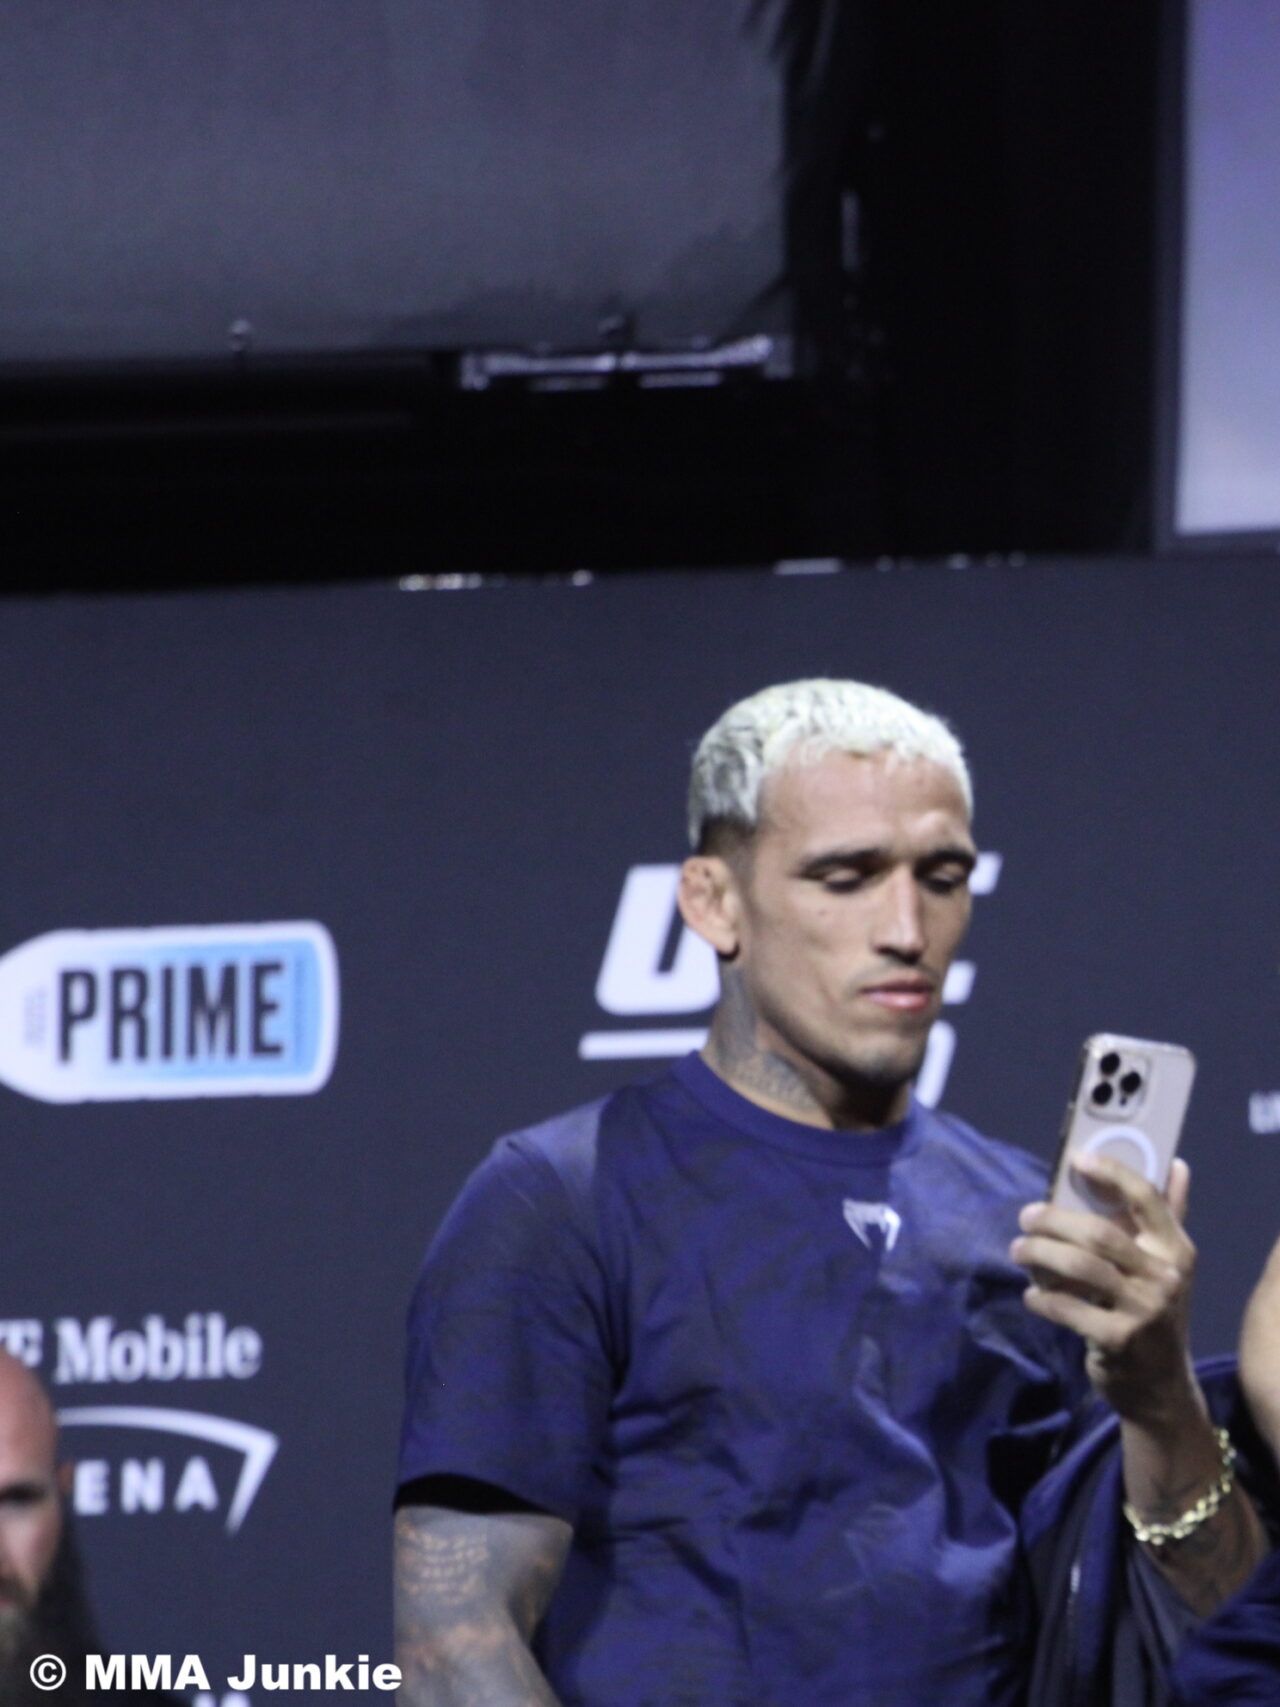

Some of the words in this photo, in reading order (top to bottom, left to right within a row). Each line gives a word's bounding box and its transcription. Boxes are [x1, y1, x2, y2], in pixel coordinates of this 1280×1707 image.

[59, 960, 284, 1065] PRIME
[54, 1311, 262, 1385] Mobile
[73, 1455, 219, 1516] ENA
